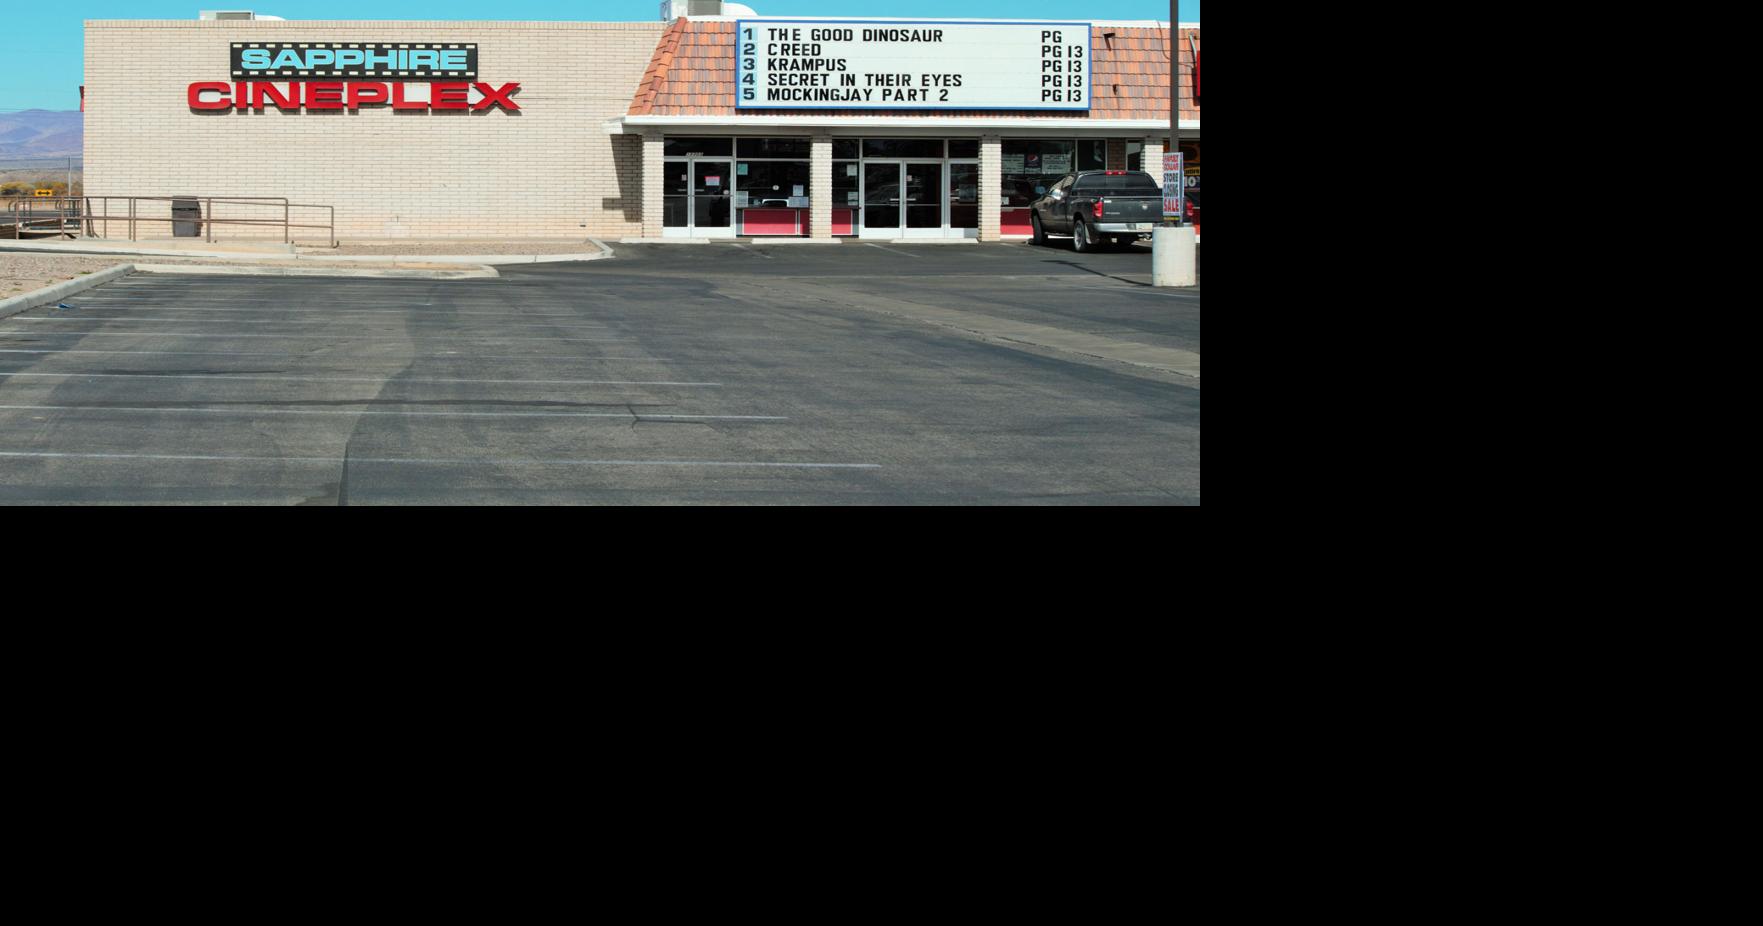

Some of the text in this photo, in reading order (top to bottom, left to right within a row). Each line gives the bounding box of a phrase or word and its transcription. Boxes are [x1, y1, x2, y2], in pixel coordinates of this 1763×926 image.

[743, 28, 1061, 43] 1 THE GOOD DINOSAUR PG
[744, 43, 1082, 58] 2 CREED PG 13
[241, 49, 467, 70] SAPPHIRE
[744, 58, 1081, 72] 3 KRAMPUS PG 13
[743, 73, 1082, 87] 4 SECRET IN THEIR EYES PG 13
[187, 81, 521, 110] CINEPLEX
[744, 88, 1081, 102] 5 MOCKINGJAY PART 2 PG 13
[1163, 173, 1179, 182] STORE
[1163, 199, 1180, 212] SALE
